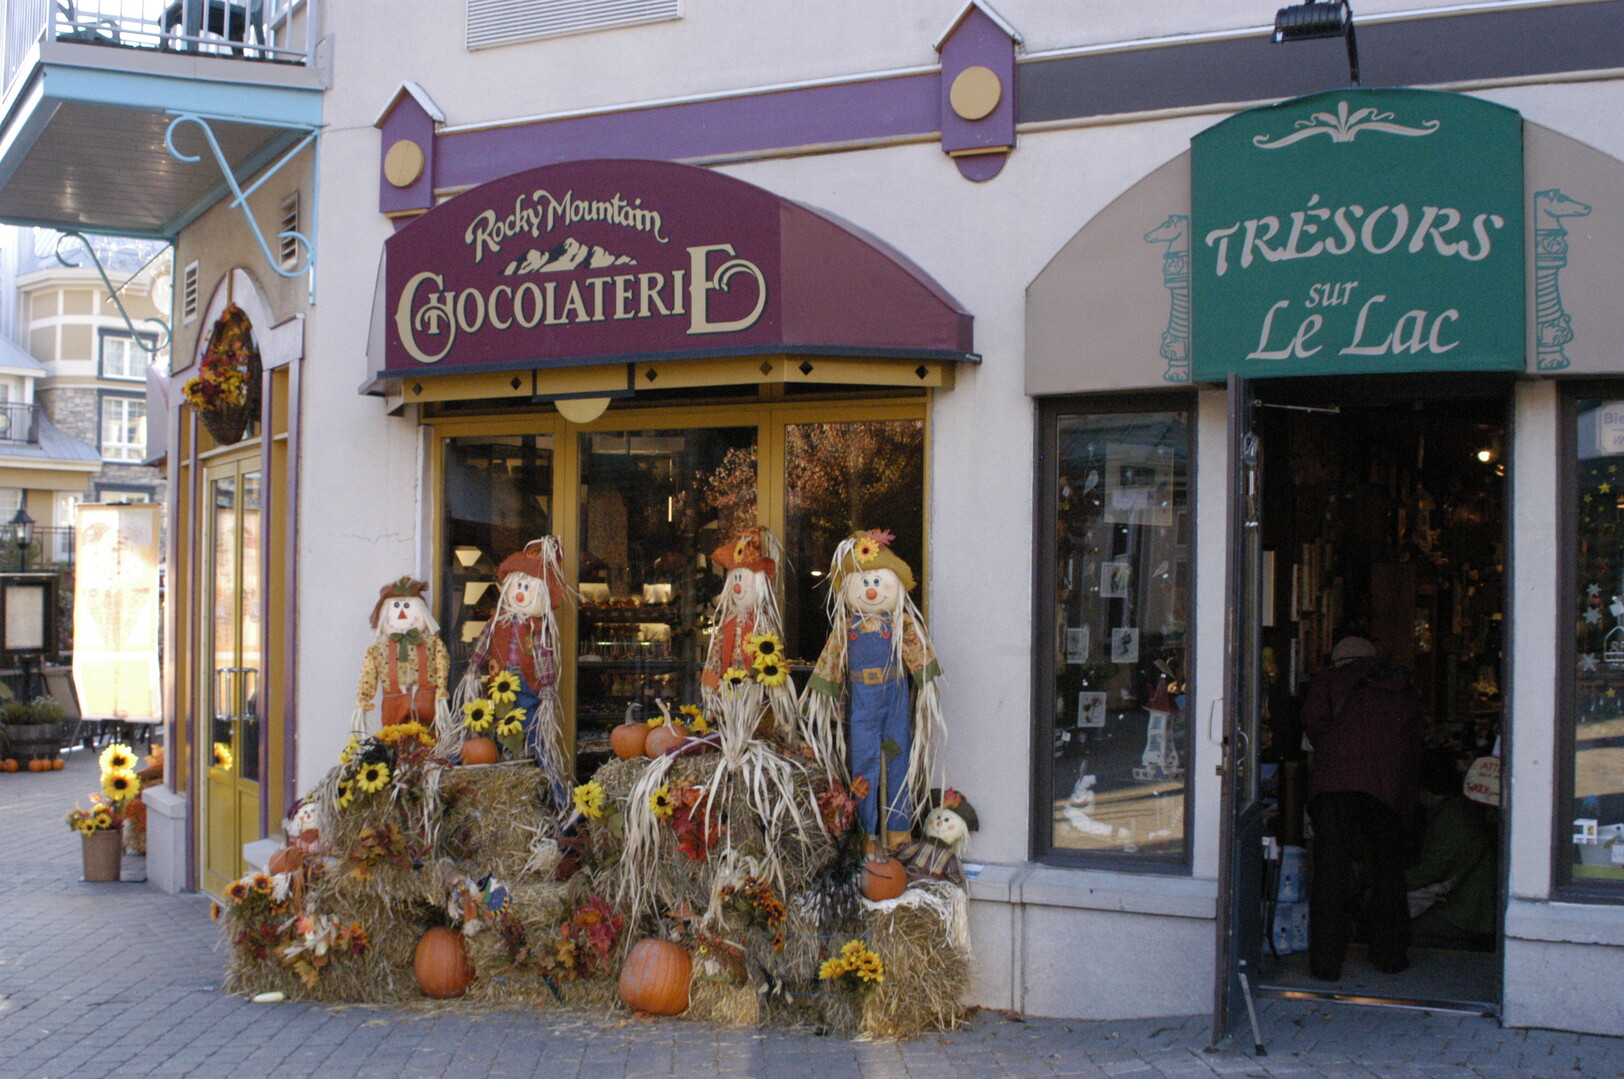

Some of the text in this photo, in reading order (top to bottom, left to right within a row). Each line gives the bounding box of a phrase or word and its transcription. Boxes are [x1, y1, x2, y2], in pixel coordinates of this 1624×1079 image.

[465, 189, 669, 264] Rocky Mountain
[1205, 194, 1504, 276] TRÉSORS
[395, 244, 767, 362] CHOCOLATERIE
[1246, 295, 1459, 360] Le Lac
[1305, 280, 1358, 308] sur
